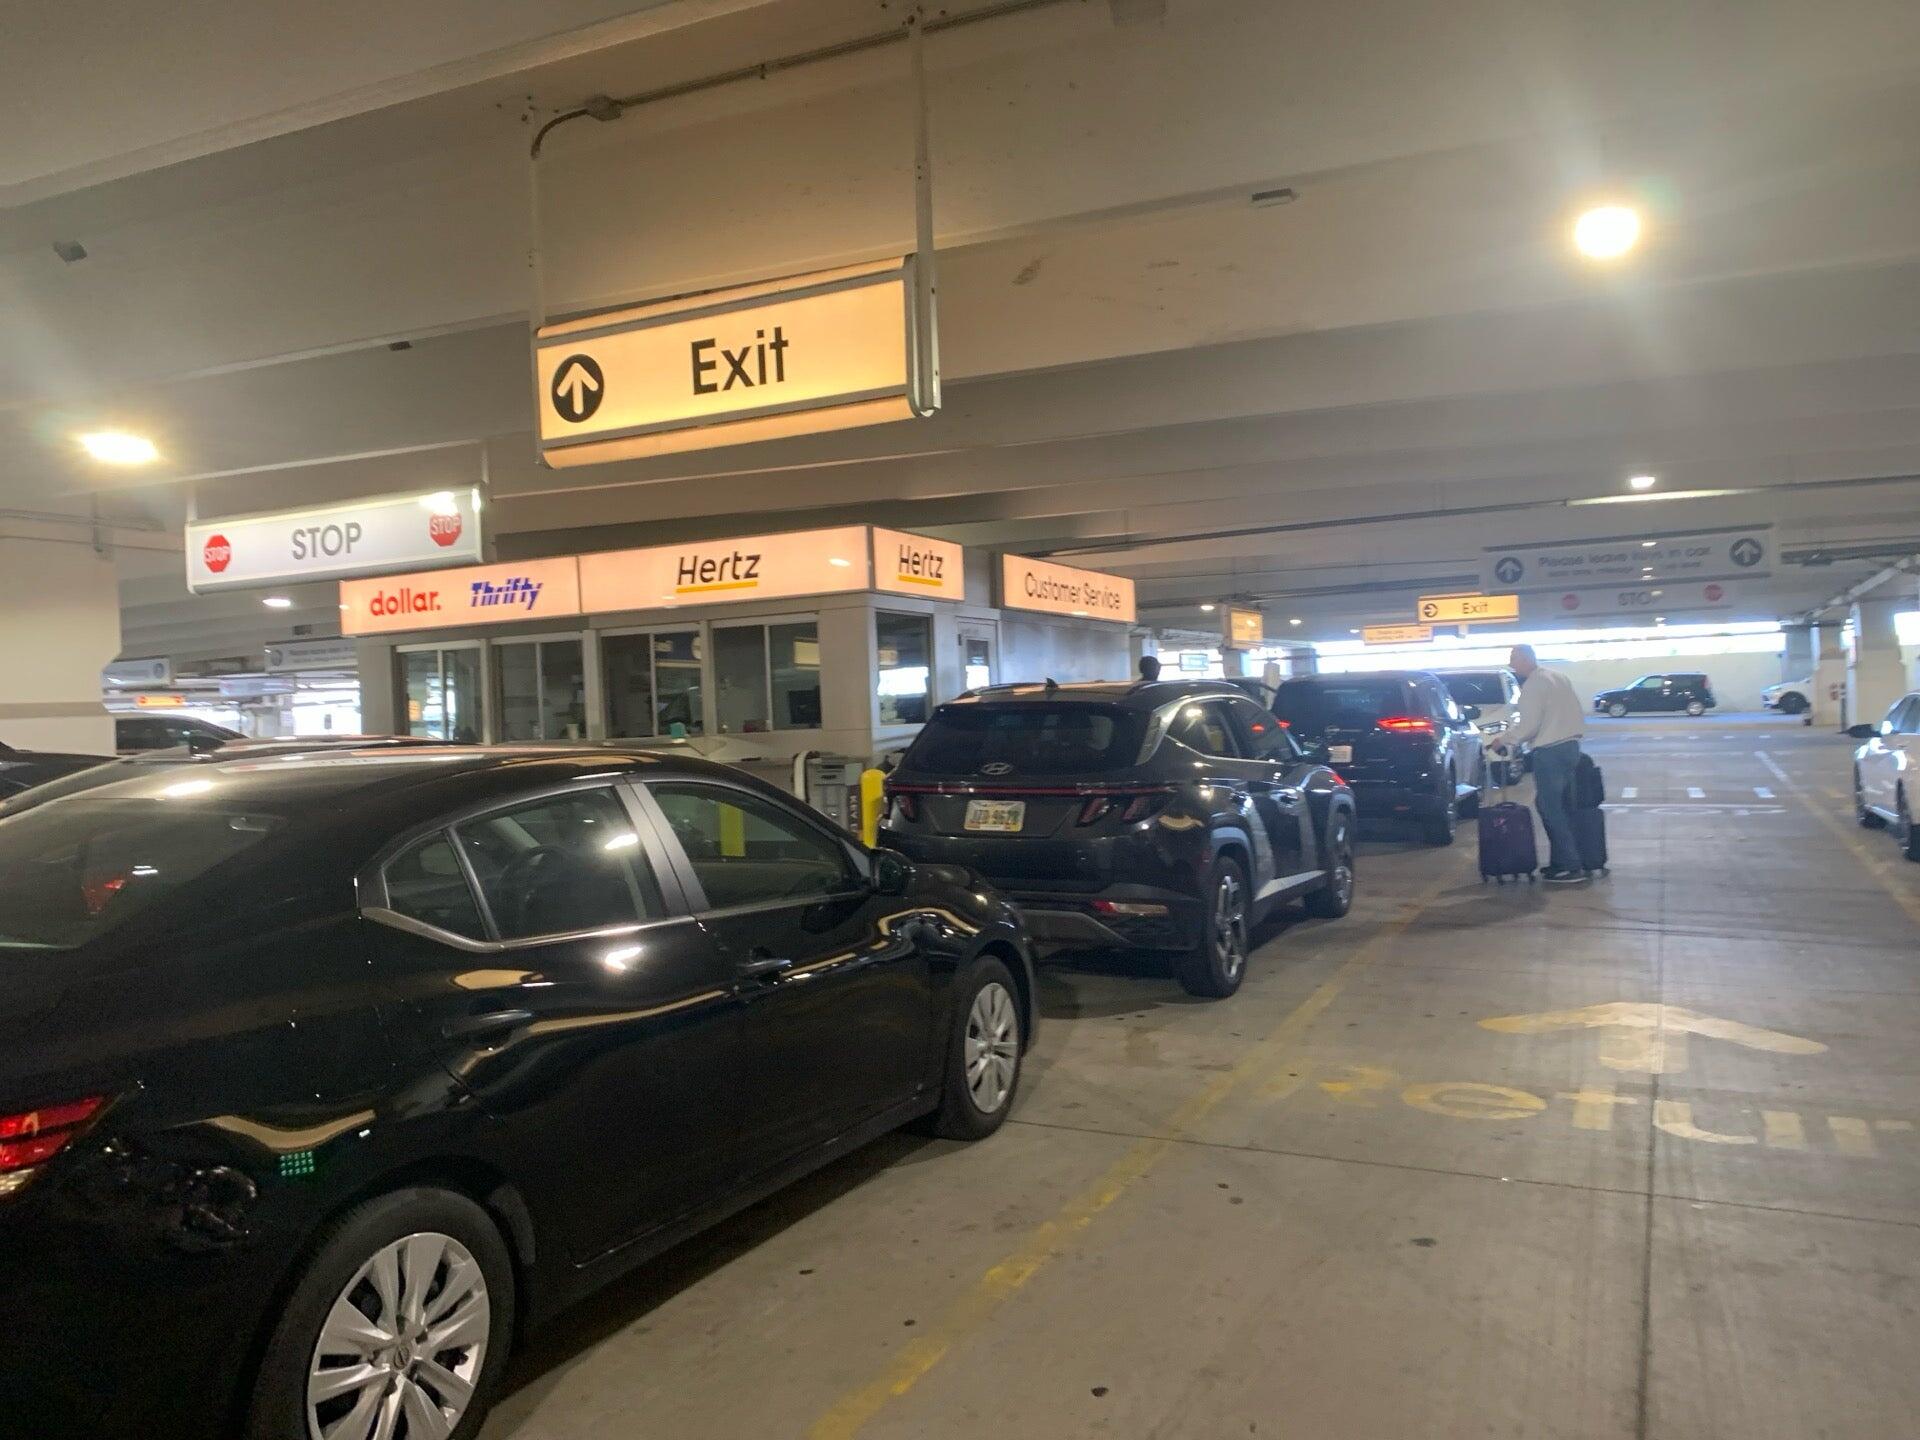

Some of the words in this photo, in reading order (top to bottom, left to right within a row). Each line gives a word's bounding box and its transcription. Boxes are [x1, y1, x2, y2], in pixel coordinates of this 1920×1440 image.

[690, 326, 789, 395] Exit
[292, 521, 362, 560] STOP
[430, 514, 461, 535] STOP
[676, 551, 762, 586] Hertz
[898, 544, 944, 579] Hertz
[470, 576, 543, 611] Thrifty
[1025, 571, 1081, 604] Customer
[1083, 581, 1121, 610] Service
[1462, 601, 1489, 615] Exit
